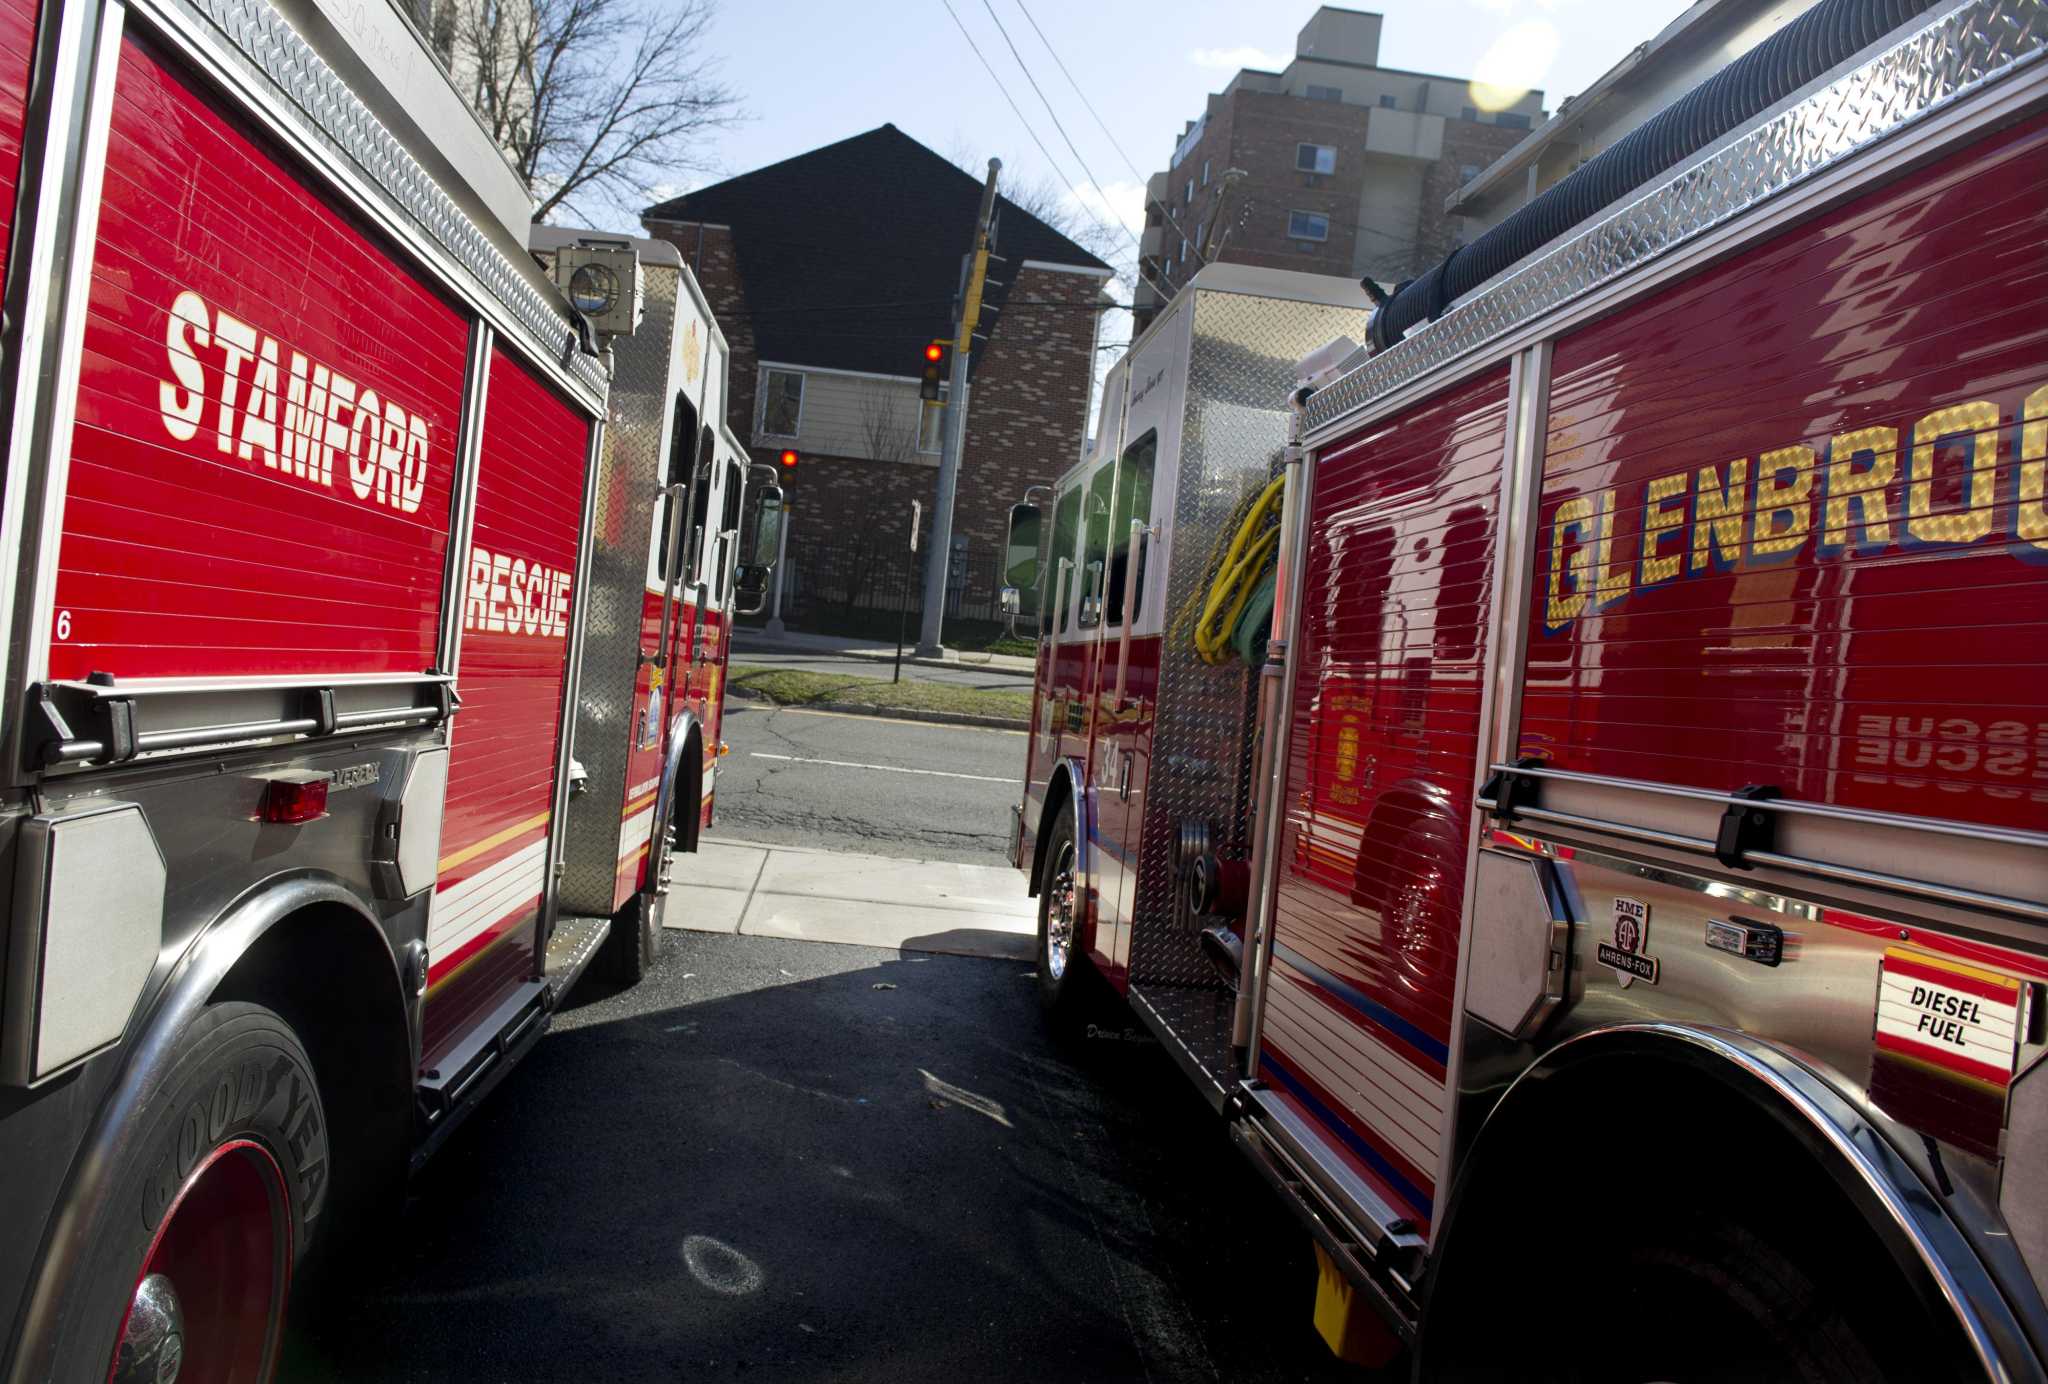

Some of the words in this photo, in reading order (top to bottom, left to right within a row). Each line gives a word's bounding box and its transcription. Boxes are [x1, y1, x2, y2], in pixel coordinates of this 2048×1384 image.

[160, 290, 430, 514] STAMFORD
[464, 547, 572, 637] RESCUE
[57, 610, 72, 640] 6
[1102, 736, 1120, 788] 34
[1615, 899, 1644, 918] HME
[1599, 947, 1652, 976] AHRENS-FOX
[1910, 986, 1981, 1025] DIESEL
[1917, 1013, 1967, 1046] FUEL
[141, 1060, 330, 1245] GOODYEA
